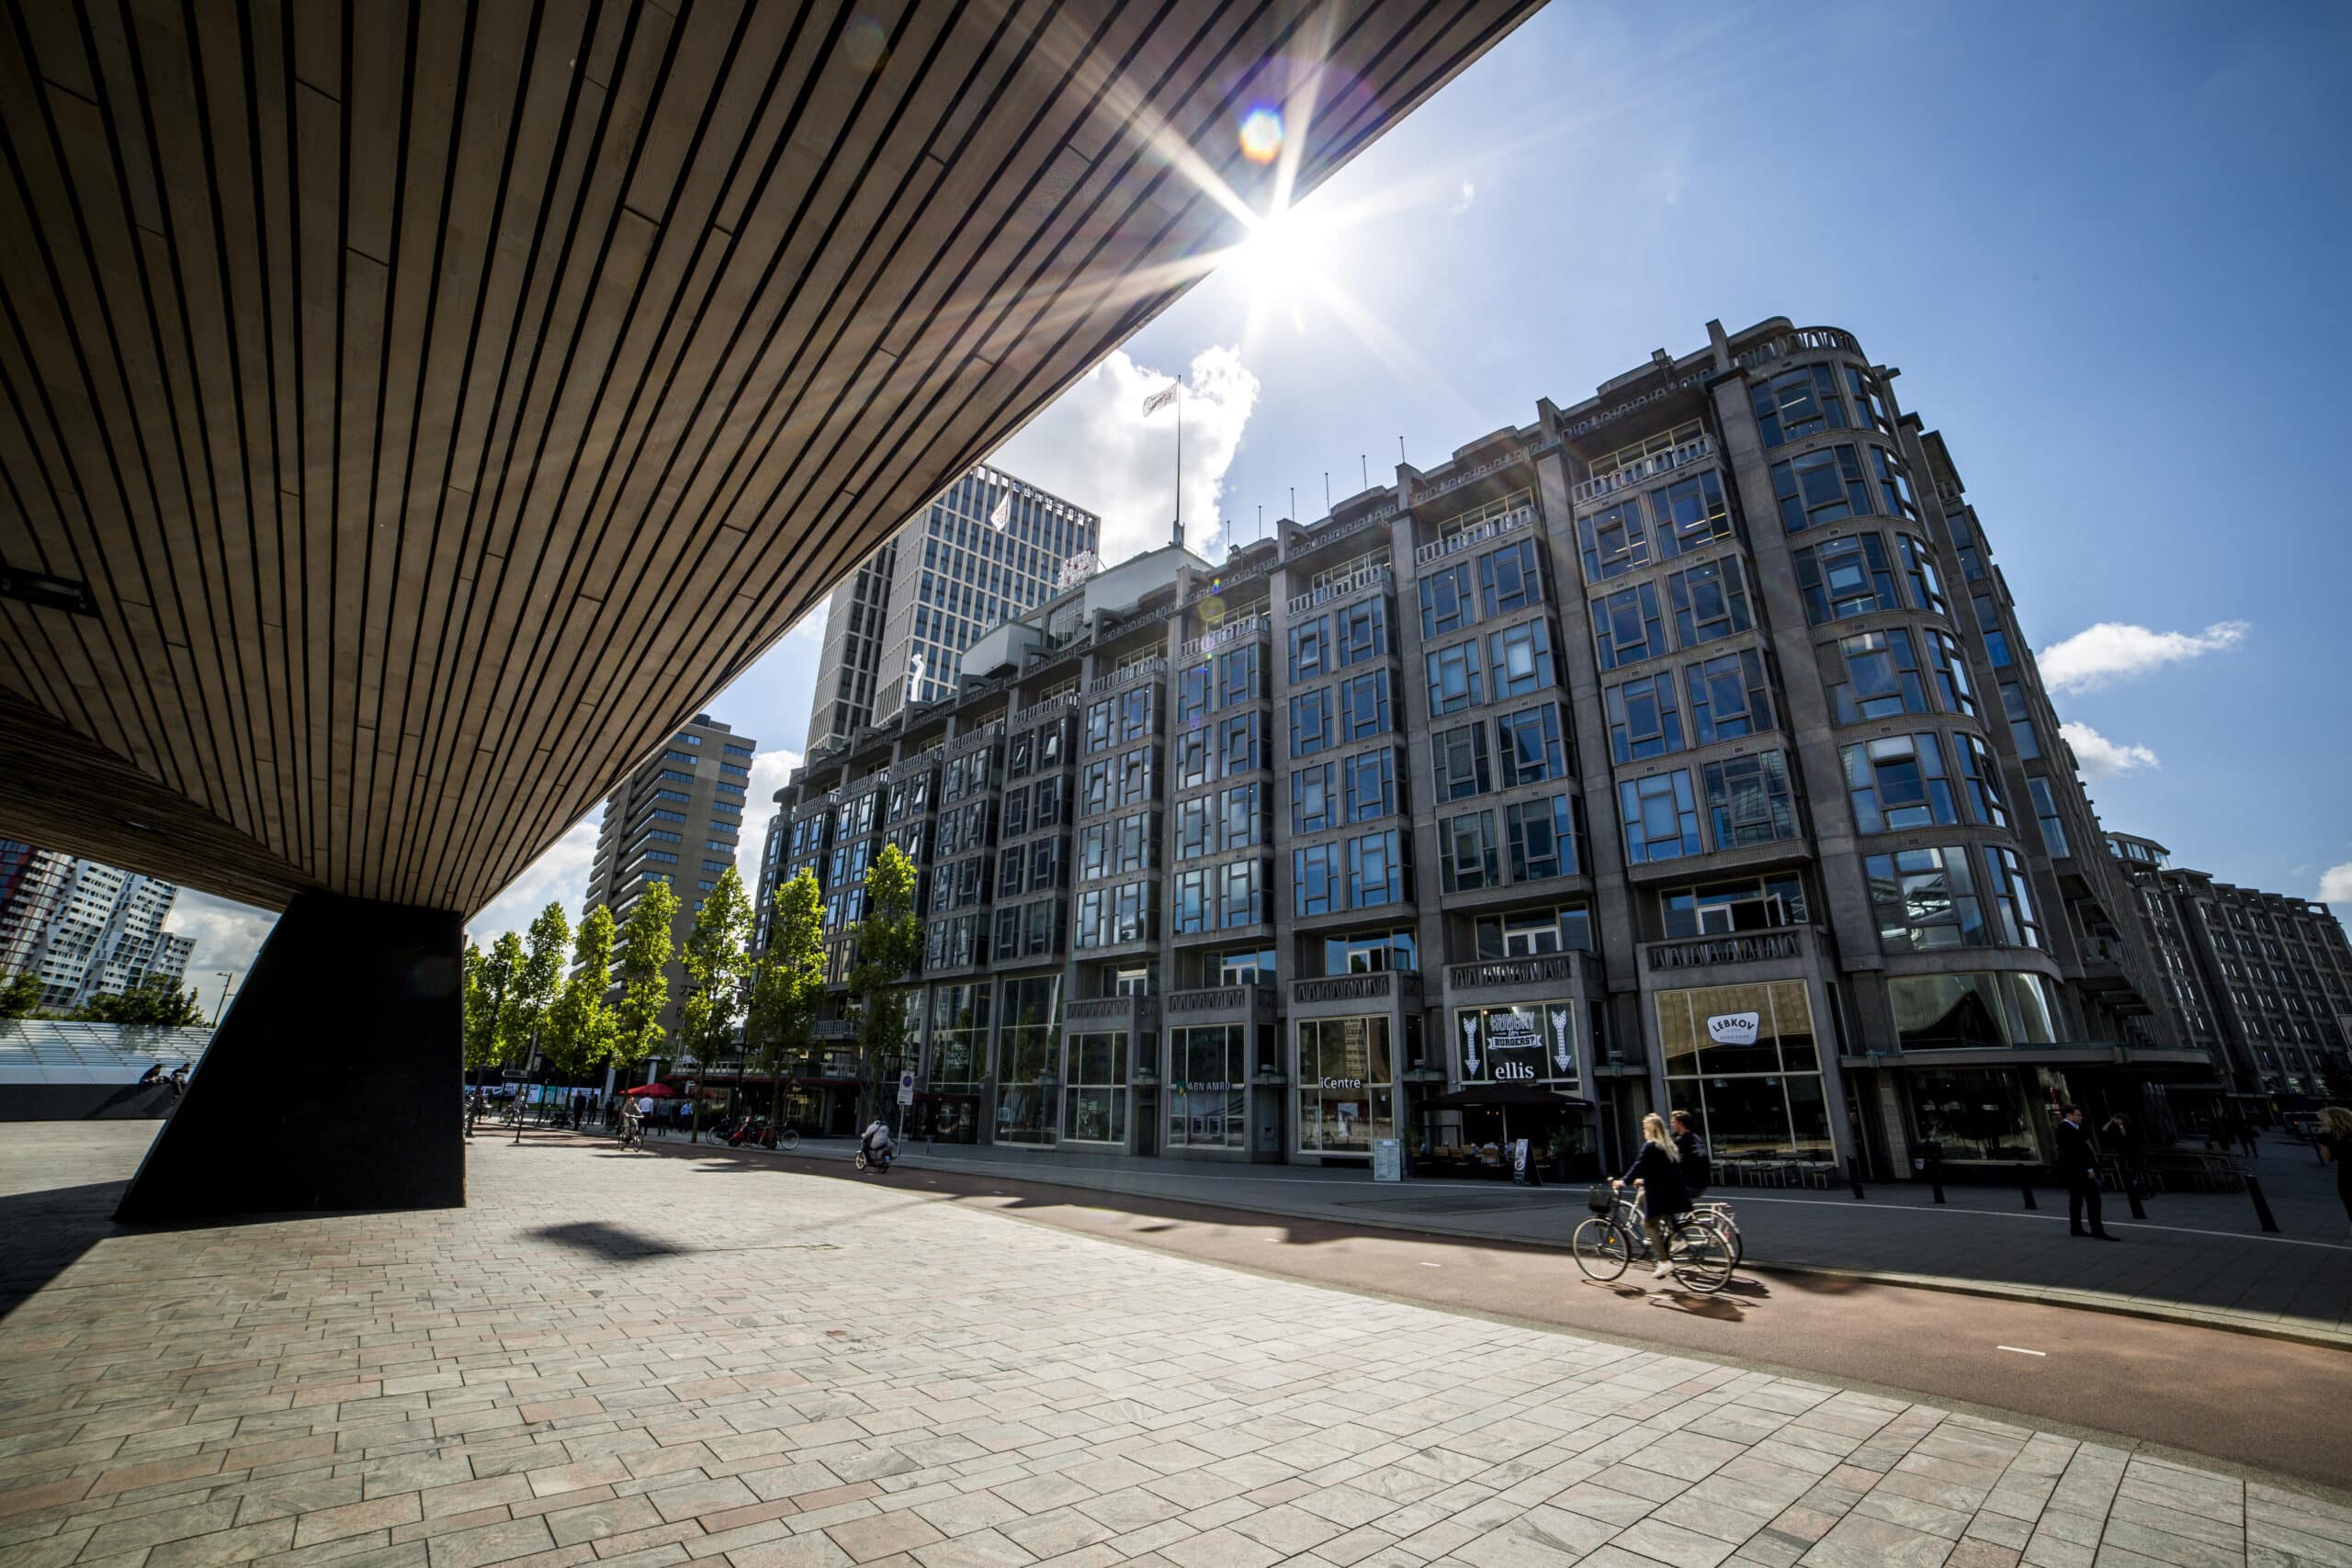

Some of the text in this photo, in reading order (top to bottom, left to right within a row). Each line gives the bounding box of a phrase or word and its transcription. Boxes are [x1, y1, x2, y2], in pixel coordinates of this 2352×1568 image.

[1713, 1019, 1755, 1032] LEBKOV
[1495, 1035, 1535, 1047] BURGERS?
[1495, 1062, 1535, 1079] ellis
[1188, 1081, 1231, 1091] ABN AMRO
[1320, 1077, 1361, 1089] iCentre
